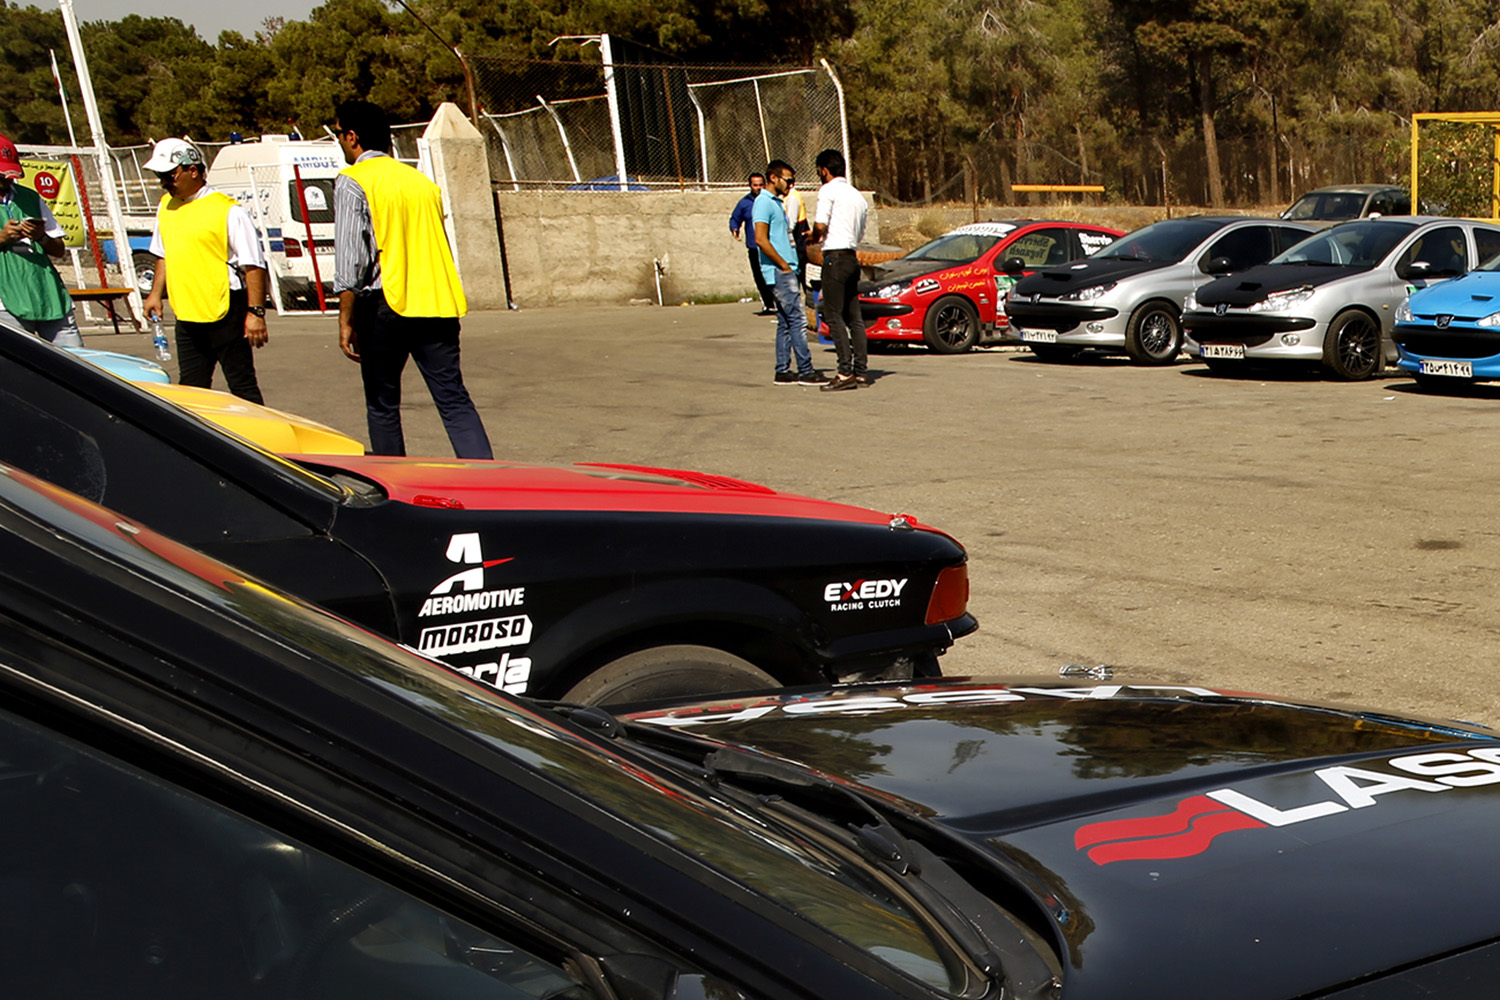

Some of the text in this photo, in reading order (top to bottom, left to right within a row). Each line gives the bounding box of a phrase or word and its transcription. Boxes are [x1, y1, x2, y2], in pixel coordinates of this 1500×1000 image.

[40, 176, 53, 186] 10
[418, 587, 525, 617] AEROMOTIVE
[824, 578, 908, 602] EXEDY
[831, 599, 901, 612] RACING CLUTCH
[422, 617, 526, 650] MOROSO
